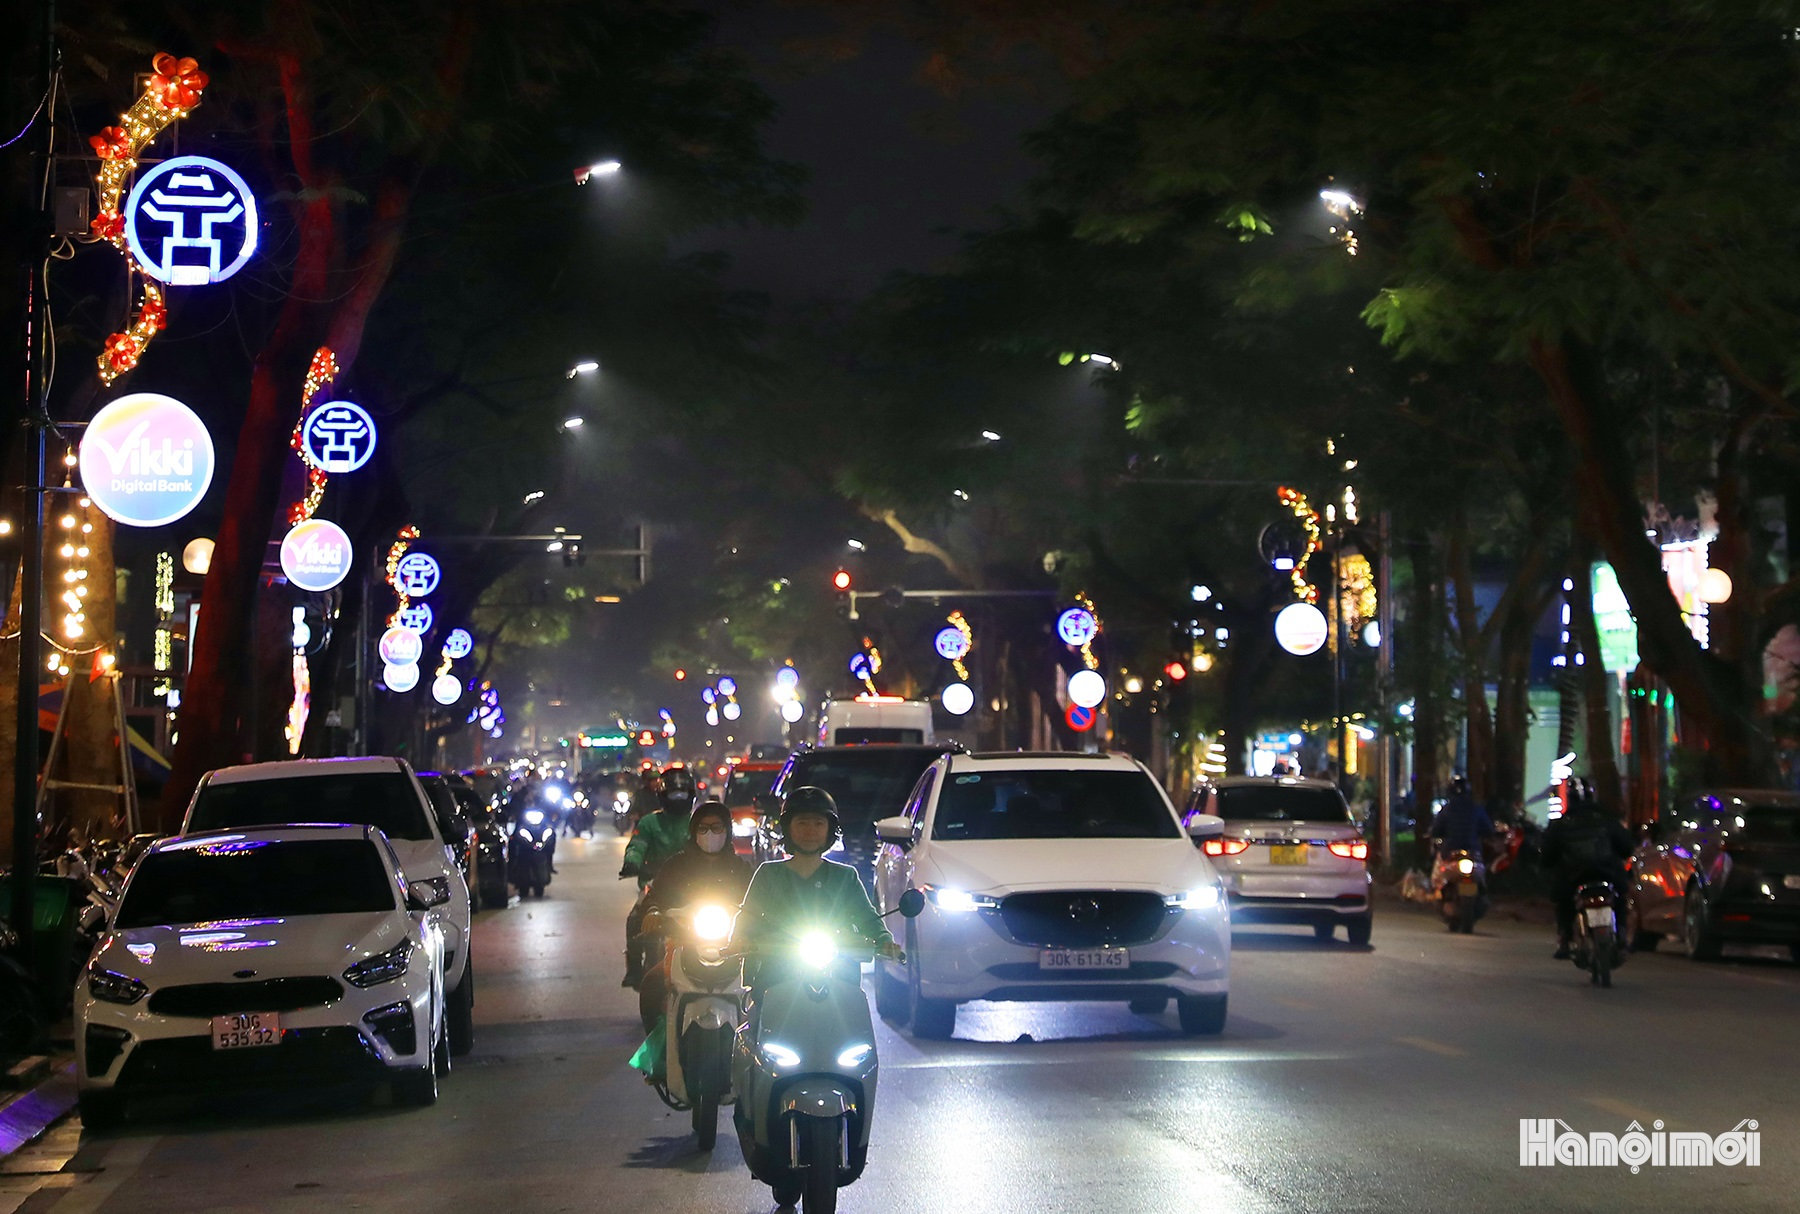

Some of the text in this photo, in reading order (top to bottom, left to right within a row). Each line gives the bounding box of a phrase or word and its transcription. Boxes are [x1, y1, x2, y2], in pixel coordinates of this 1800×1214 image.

[93, 420, 194, 476] Vikki
[231, 1014, 260, 1030] 30G
[220, 1030, 273, 1047] 535.32
